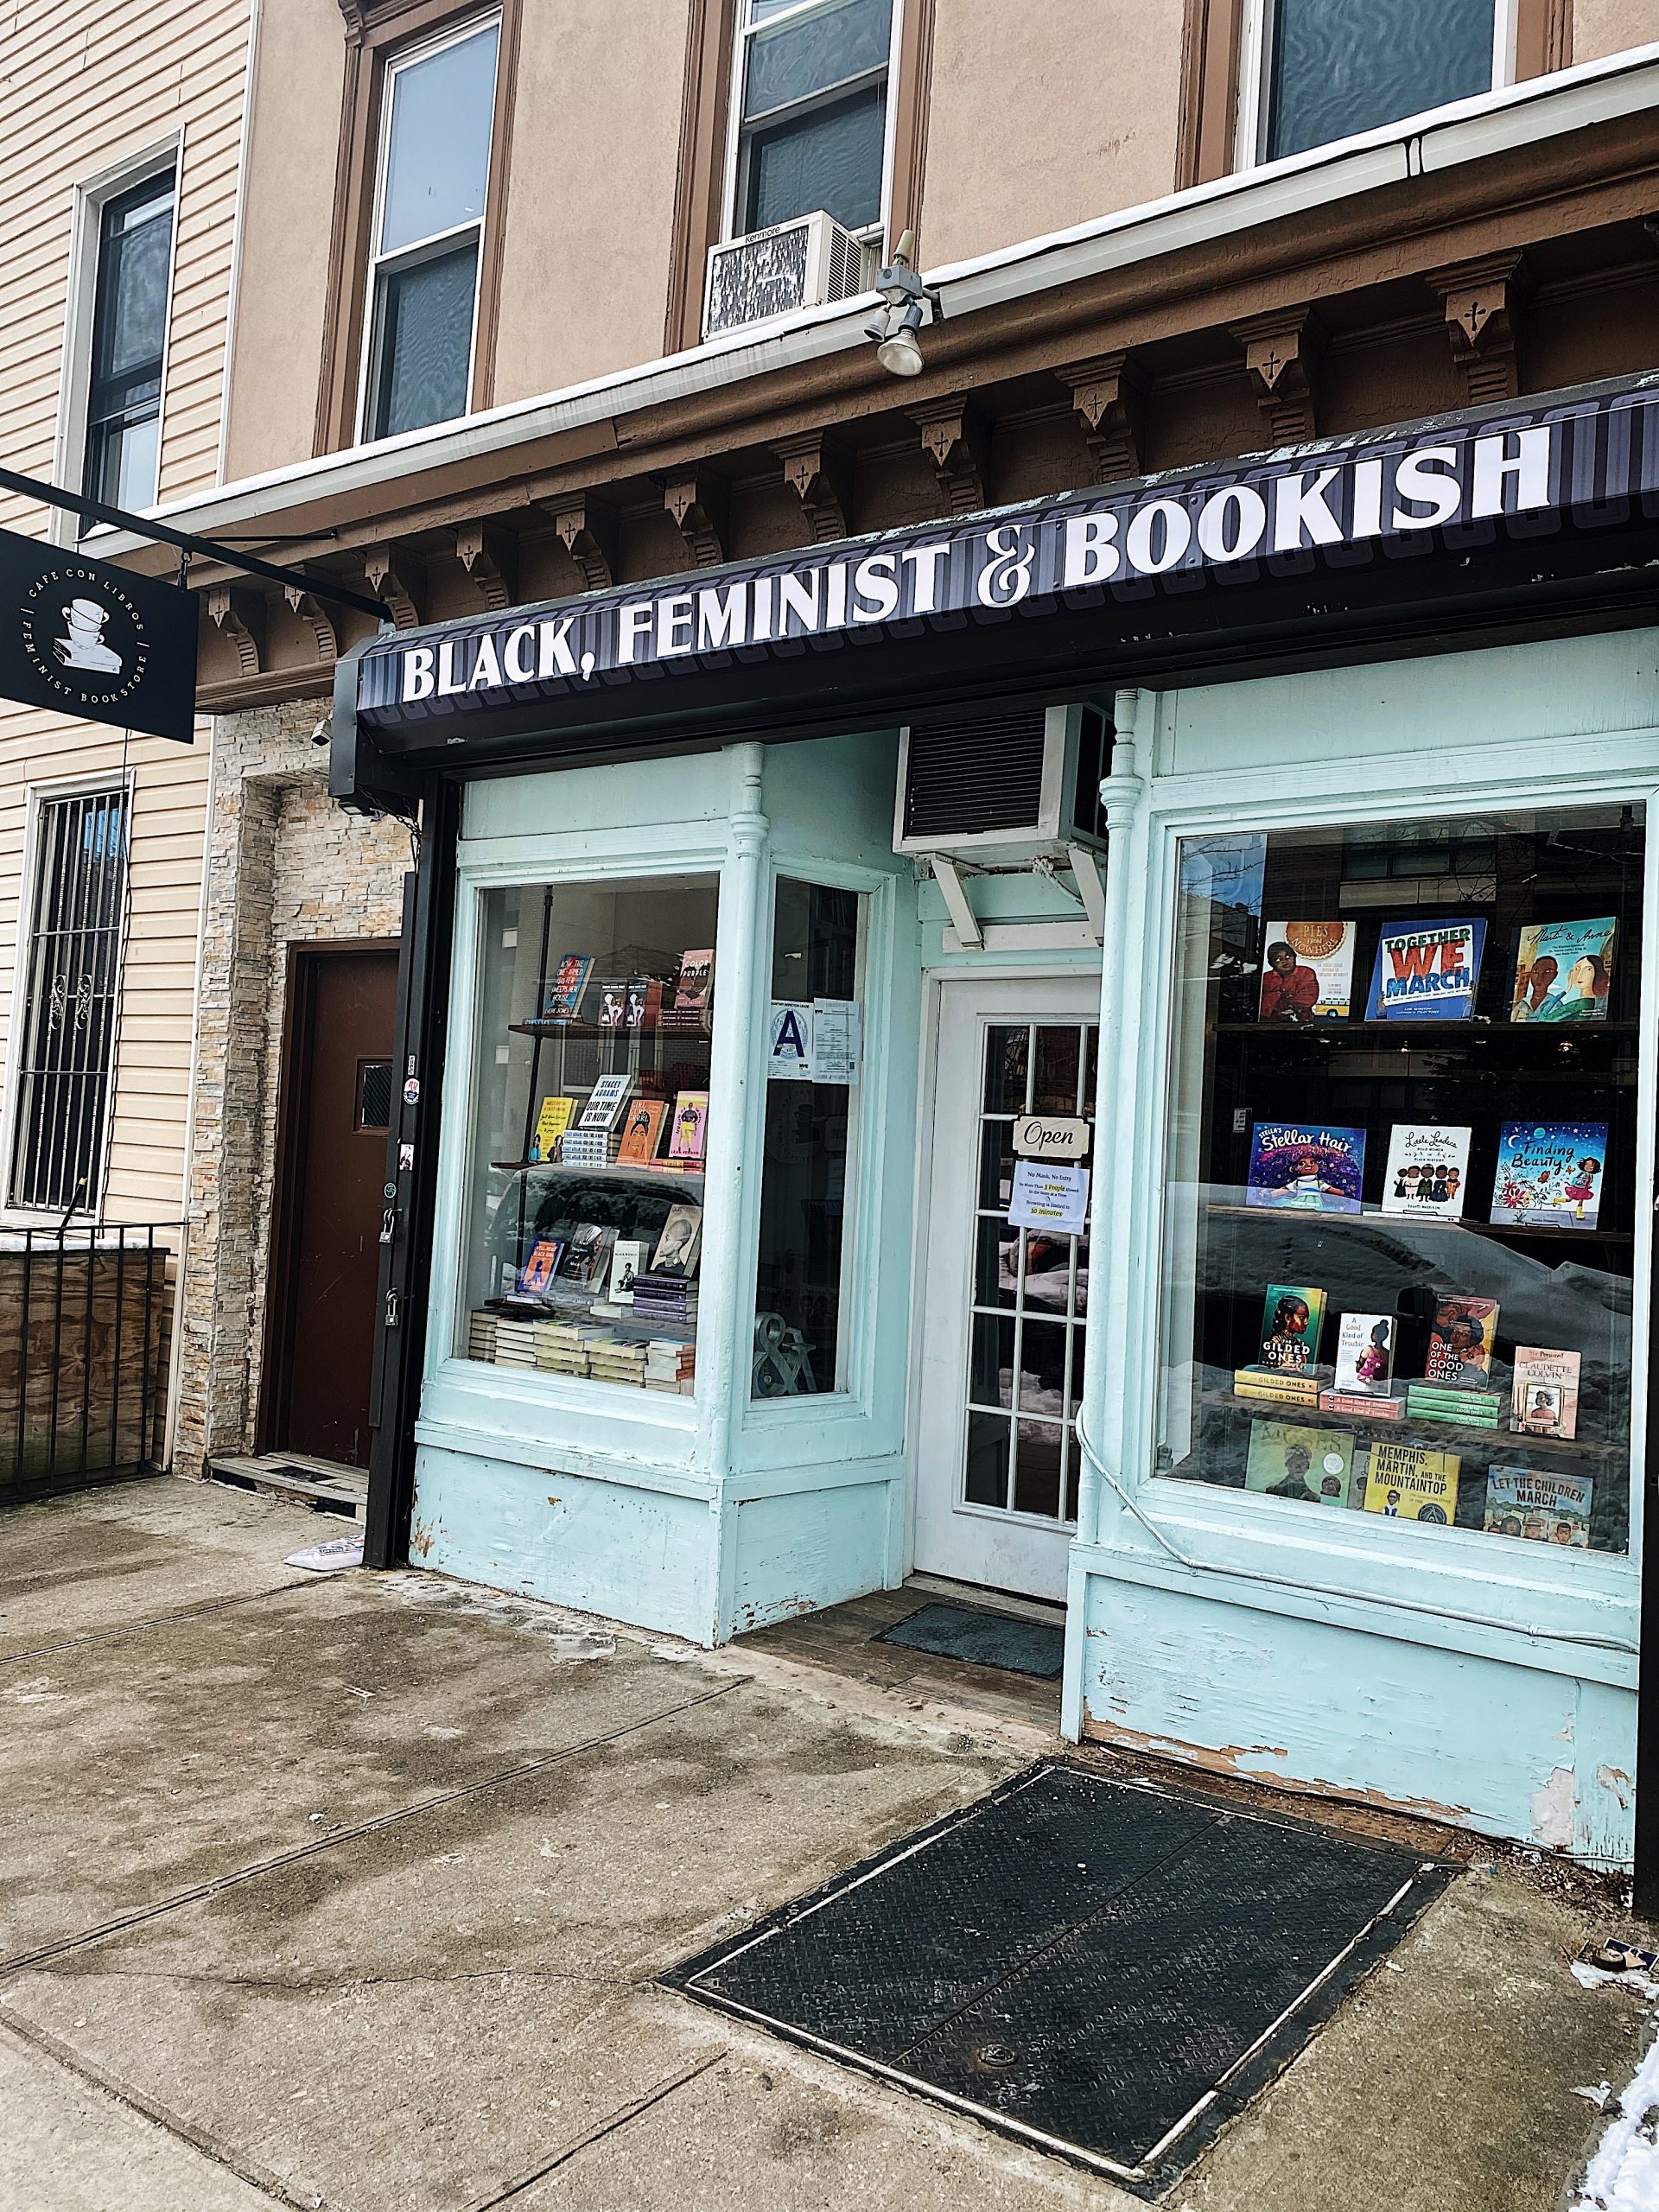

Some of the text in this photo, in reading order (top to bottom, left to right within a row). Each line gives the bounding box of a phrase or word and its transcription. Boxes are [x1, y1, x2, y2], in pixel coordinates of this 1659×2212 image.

[745, 226, 781, 244] Kenmore
[401, 427, 1552, 702] BLACK, FEMINIST & BOOKISH
[29, 569, 144, 631] CAFE CON LIBROS
[22, 620, 147, 703] FEMINIST BOOKSTORE
[1303, 925, 1329, 938] PIES
[1527, 925, 1568, 945] Martin
[1577, 929, 1612, 943] Anne
[1292, 937, 1338, 954] NOWHERE
[1384, 928, 1471, 953] TOGETHER
[684, 959, 709, 968] COLOR
[1389, 939, 1465, 982] WE
[1385, 967, 1471, 998] MARCH
[772, 1010, 805, 1058] A
[601, 1080, 622, 1089] STACEY
[586, 1102, 618, 1112] OUR TIME
[583, 1113, 610, 1122] IS NOW
[1023, 1121, 1074, 1152] Open
[1258, 1127, 1282, 1139] STELLA'S
[1262, 1129, 1353, 1152] Stellar Hair
[1428, 1130, 1459, 1148] Leaders
[1523, 1140, 1575, 1163] Finding
[1511, 1154, 1564, 1175] Beauty
[1345, 1322, 1362, 1331] Good
[1262, 1341, 1311, 1355] GILDED
[1431, 1341, 1453, 1352] ONE
[1268, 1351, 1303, 1363] ONES
[1429, 1359, 1464, 1371] GOOD
[1443, 1352, 1459, 1361] THE
[1427, 1369, 1458, 1382] ONES
[1519, 1361, 1573, 1374] CLAUDETTE
[1527, 1370, 1563, 1380] COLVIN
[1258, 1376, 1284, 1385] GILDED
[1257, 1390, 1284, 1400] GILDED
[1261, 1423, 1342, 1452] MOSES
[1375, 1471, 1447, 1496] MOUNTAINTOP
[1421, 1471, 1433, 1479] AND
[1434, 1473, 1446, 1482] THE
[1492, 1477, 1586, 1503] LET THE CHILDREN
[1516, 1490, 1558, 1508] MARCH
